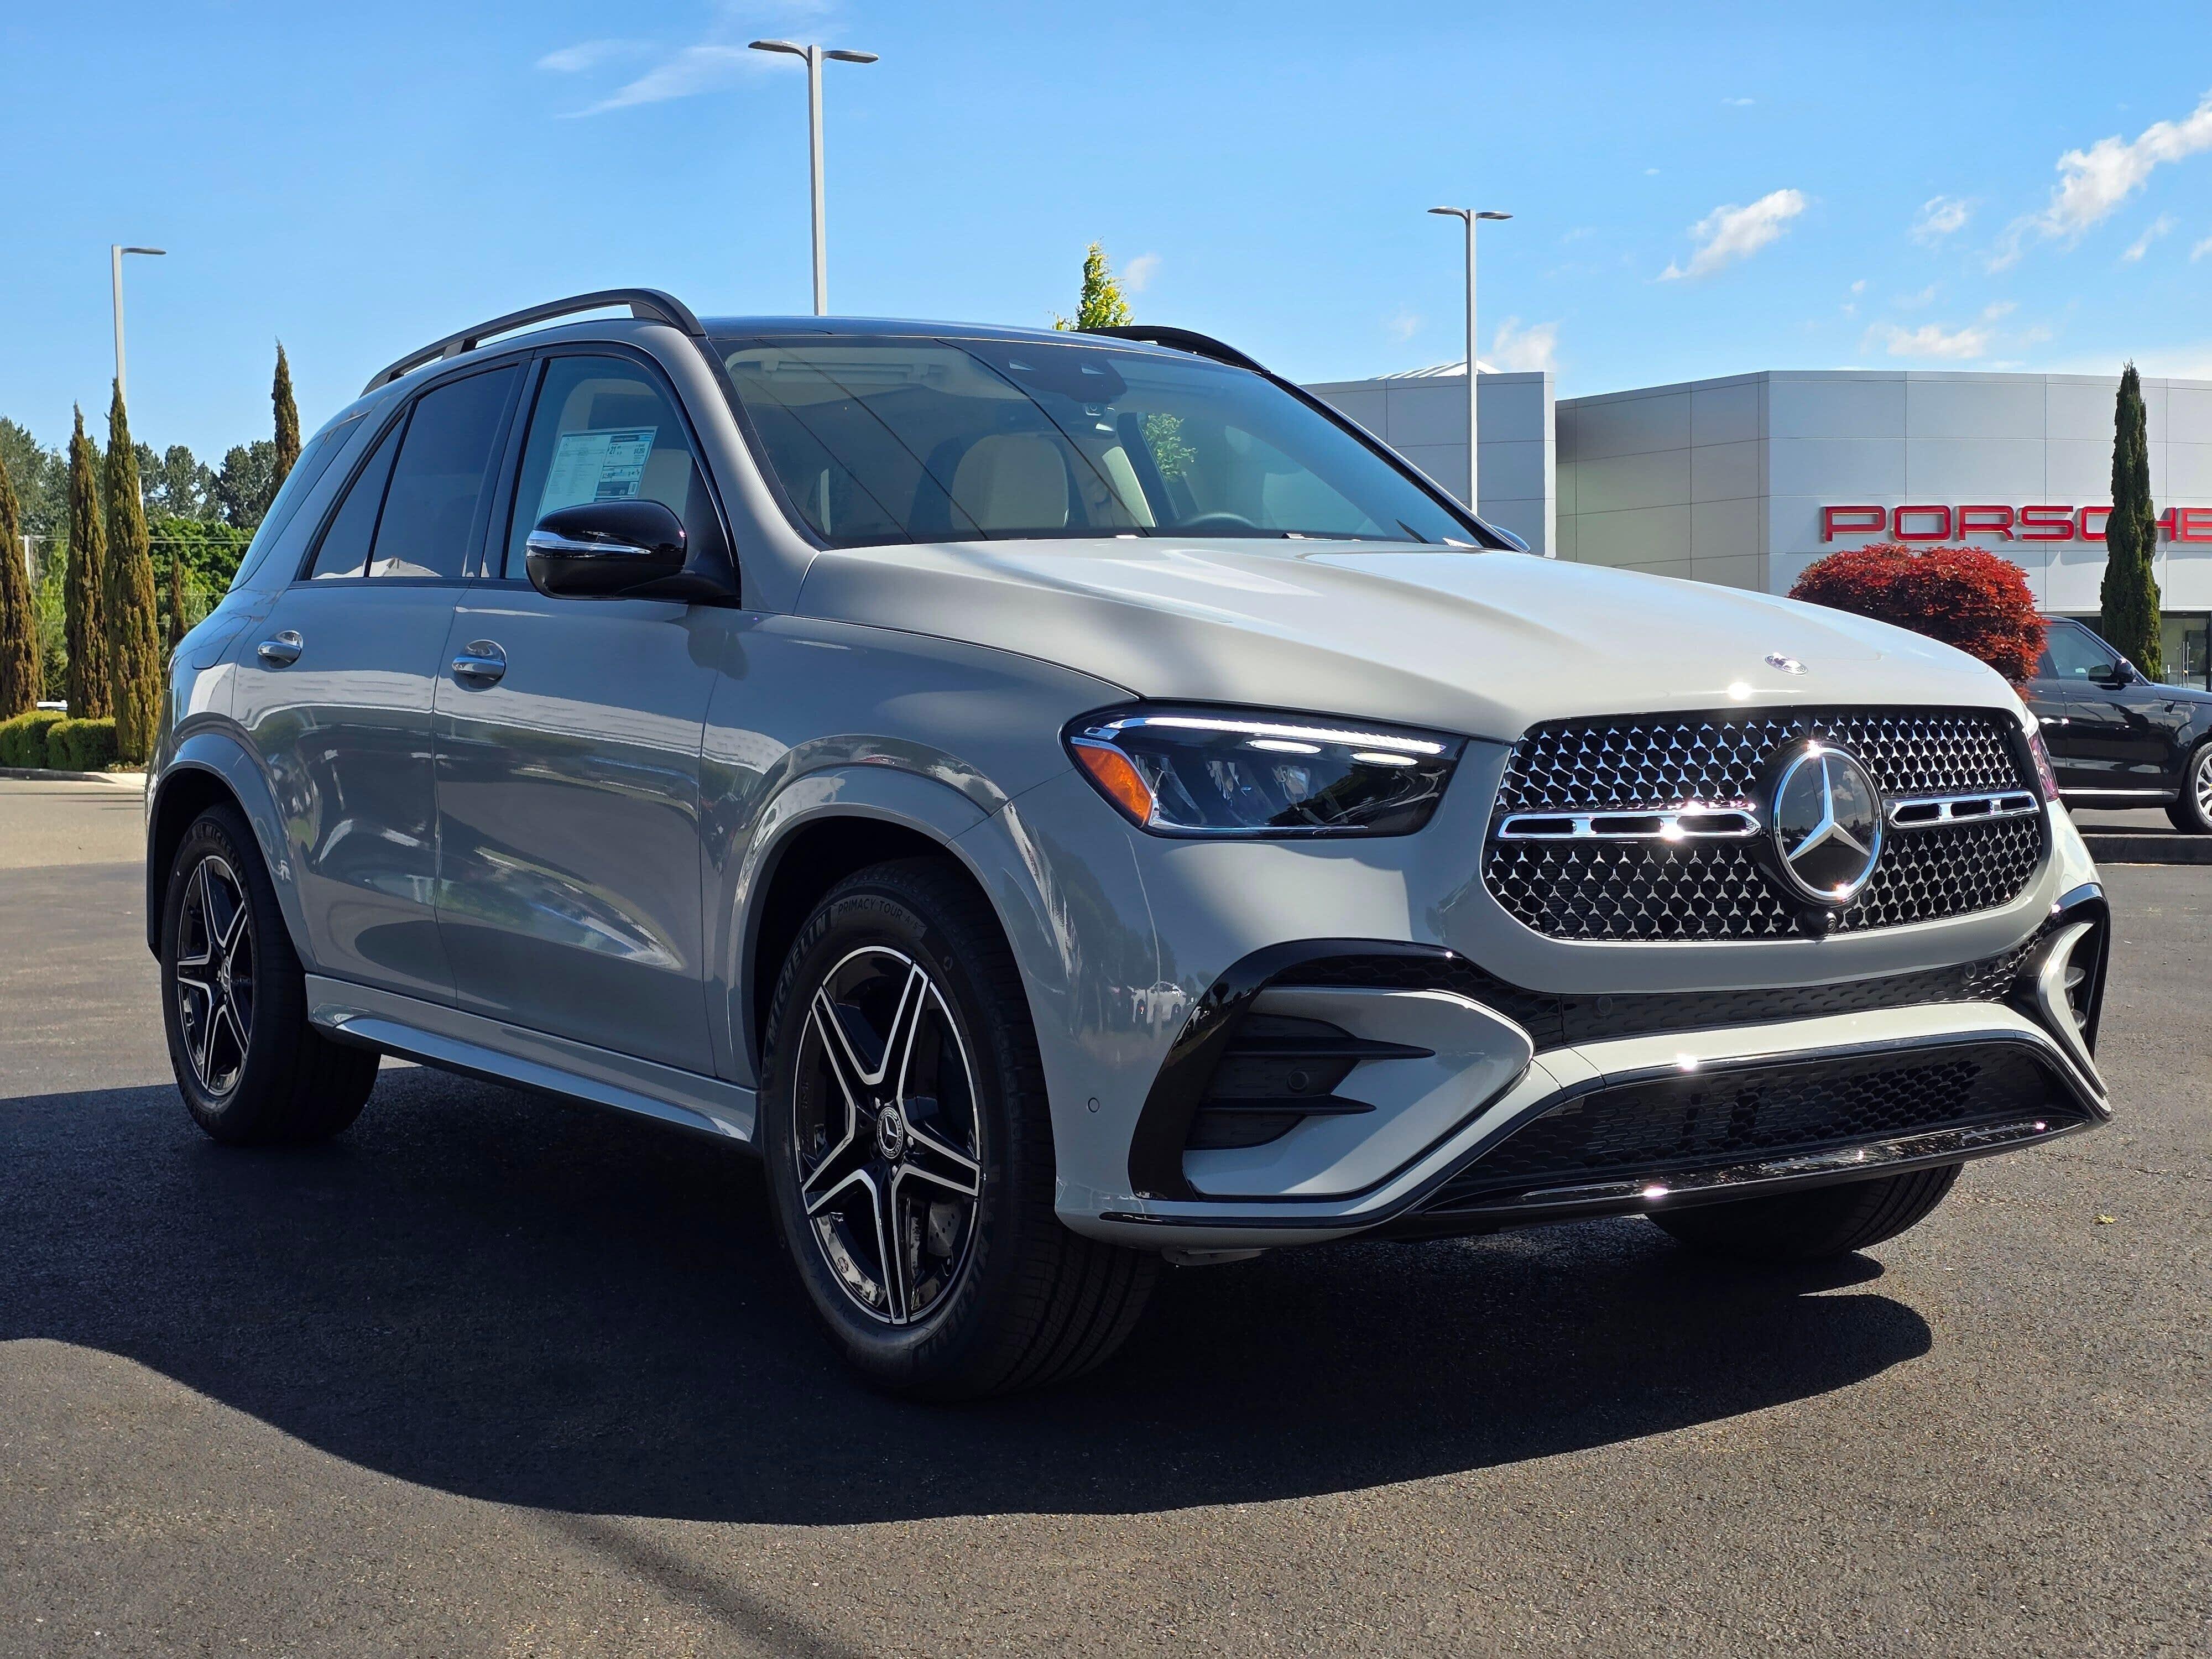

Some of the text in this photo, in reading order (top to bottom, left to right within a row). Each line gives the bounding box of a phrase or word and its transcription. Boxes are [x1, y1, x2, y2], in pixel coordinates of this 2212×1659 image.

[205, 824, 244, 884] MICHELIN
[767, 912, 827, 1046] MICHELIN
[837, 898, 876, 916] PRIMACY
[879, 900, 903, 920] TOUR
